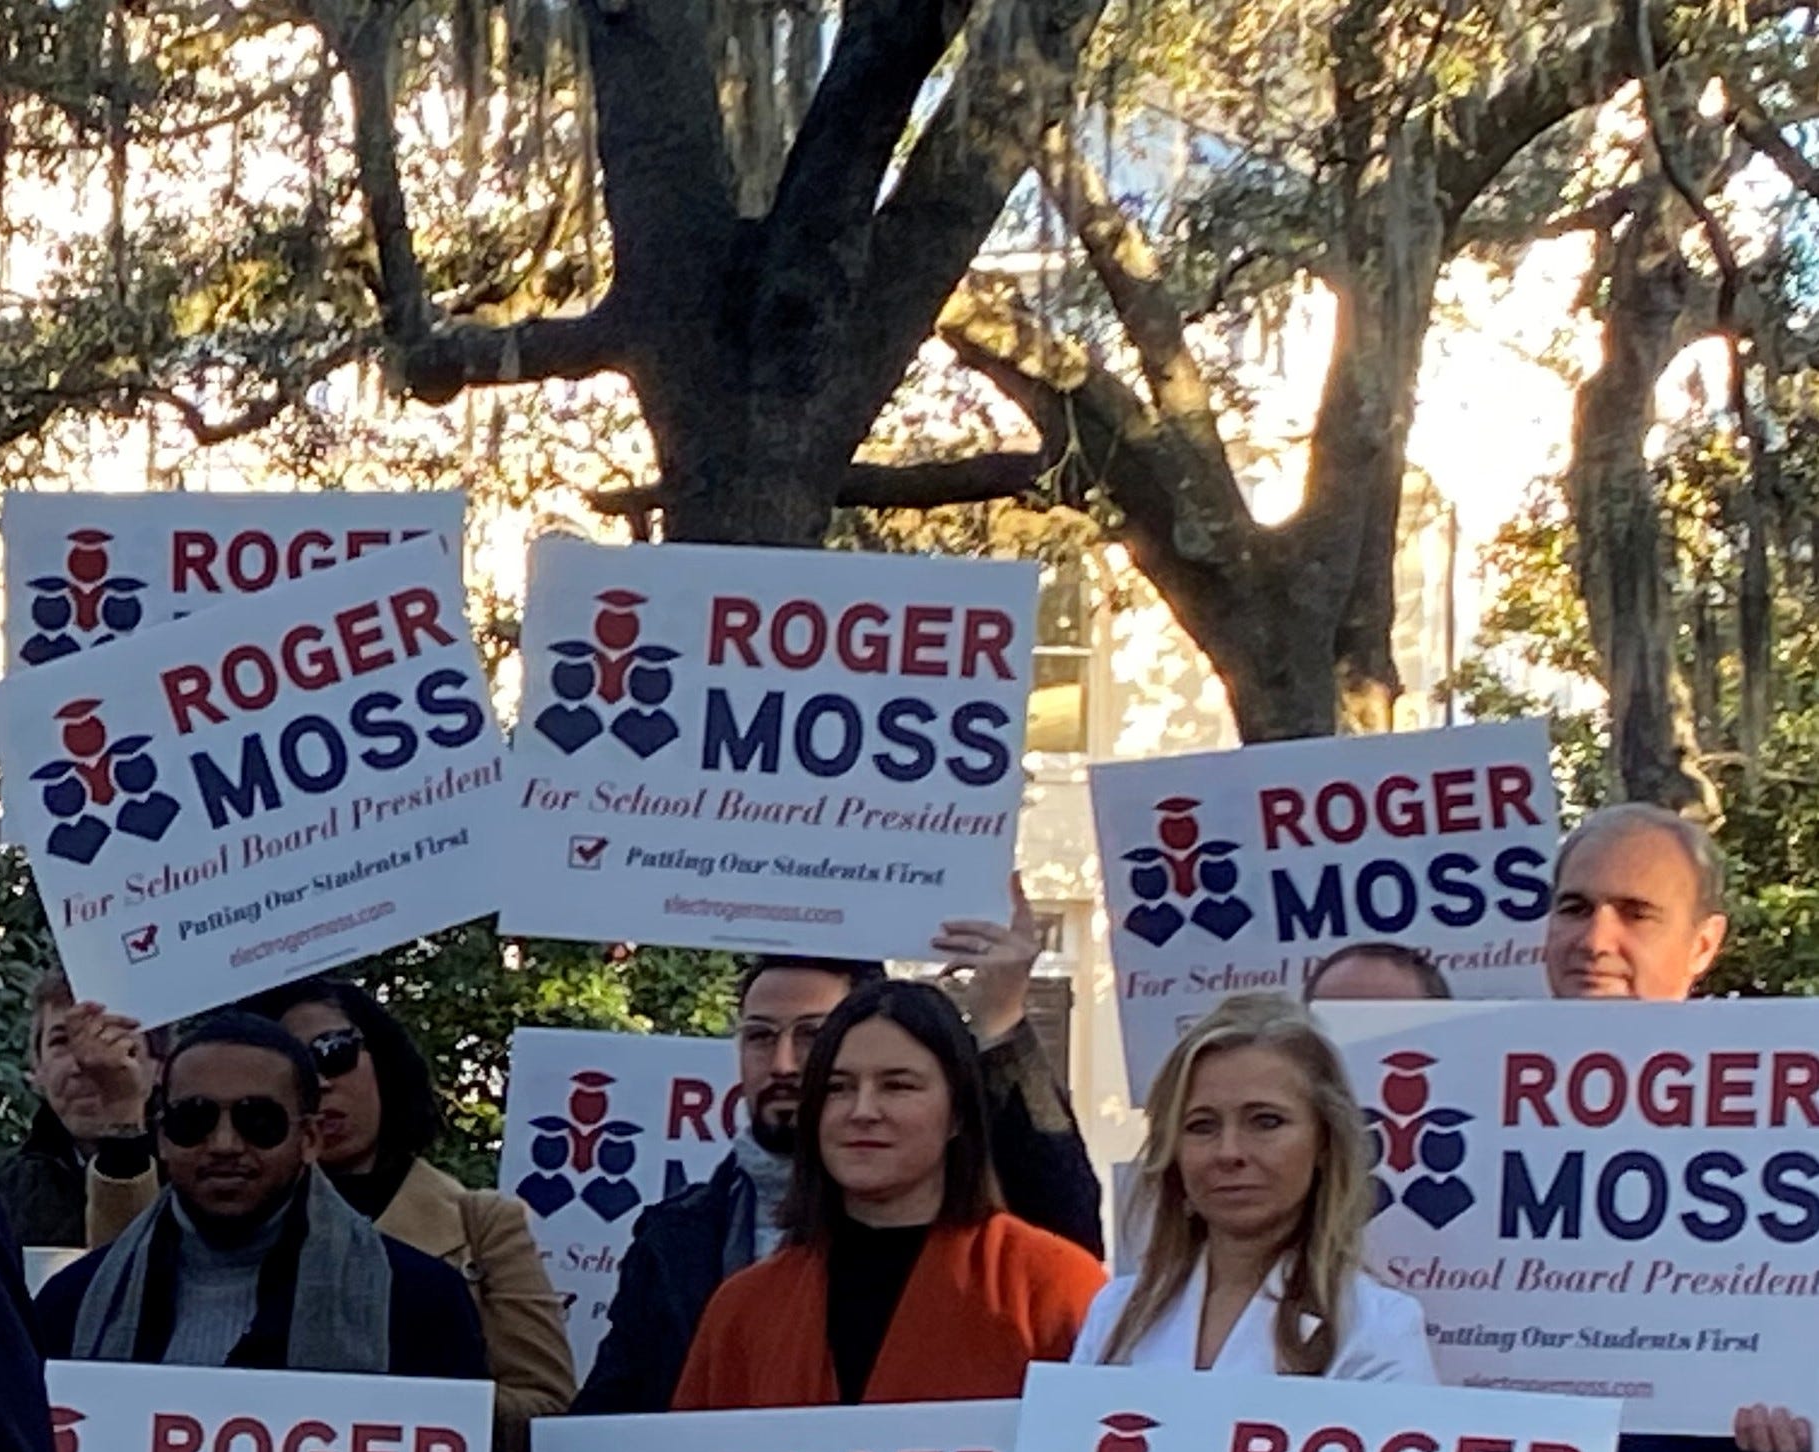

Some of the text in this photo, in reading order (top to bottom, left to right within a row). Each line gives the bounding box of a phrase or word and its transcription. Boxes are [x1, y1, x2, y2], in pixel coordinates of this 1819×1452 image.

[172, 529, 433, 593] ROG
[160, 586, 460, 735] ROGER
[707, 596, 1018, 681] ROGER
[189, 667, 485, 829] MOSS
[701, 687, 1011, 786] MOSS
[61, 757, 503, 931] For School Board President
[520, 777, 1008, 838] For School Board President
[1259, 765, 1542, 851] ROGER
[178, 827, 470, 941] Putting Our Students First
[626, 846, 946, 886] Putting Our Students First
[1272, 846, 1556, 944] MOSS
[1126, 971, 1174, 999] For
[1188, 957, 1288, 992] School
[1501, 1050, 1819, 1131] ROGER
[1498, 1150, 1819, 1243] MOSS
[1387, 1255, 1506, 1292] School
[1515, 1257, 1635, 1294] Board
[1521, 1325, 1574, 1348] Our
[1579, 1325, 1691, 1351] Students
[1695, 1328, 1760, 1353] First
